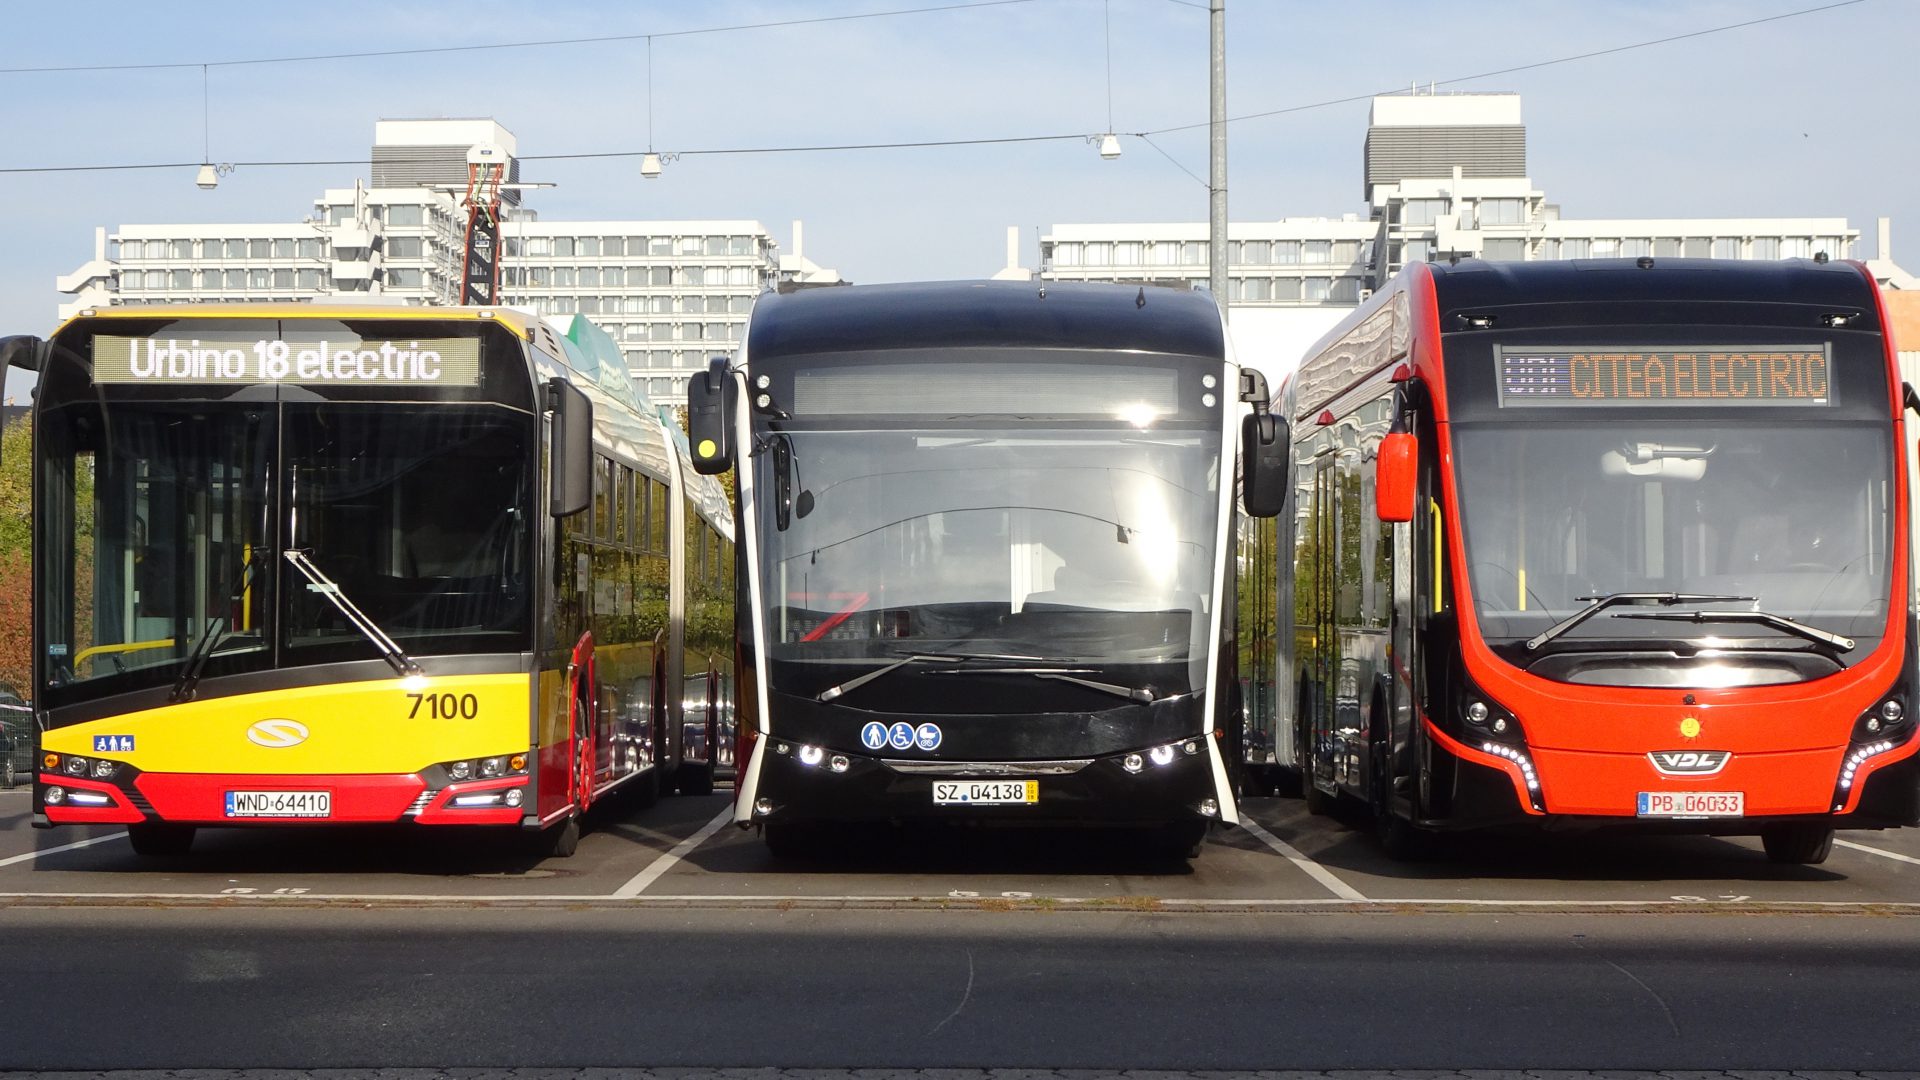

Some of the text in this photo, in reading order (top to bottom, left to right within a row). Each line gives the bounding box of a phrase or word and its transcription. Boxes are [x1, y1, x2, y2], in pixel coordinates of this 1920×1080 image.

[130, 339, 441, 379] Urbino 18 electric
[406, 693, 478, 720] 7100
[1661, 753, 1716, 767] VDL
[970, 784, 1023, 800] 04138
[236, 794, 328, 811] WND 64410
[1651, 796, 1738, 811] PB 06033
